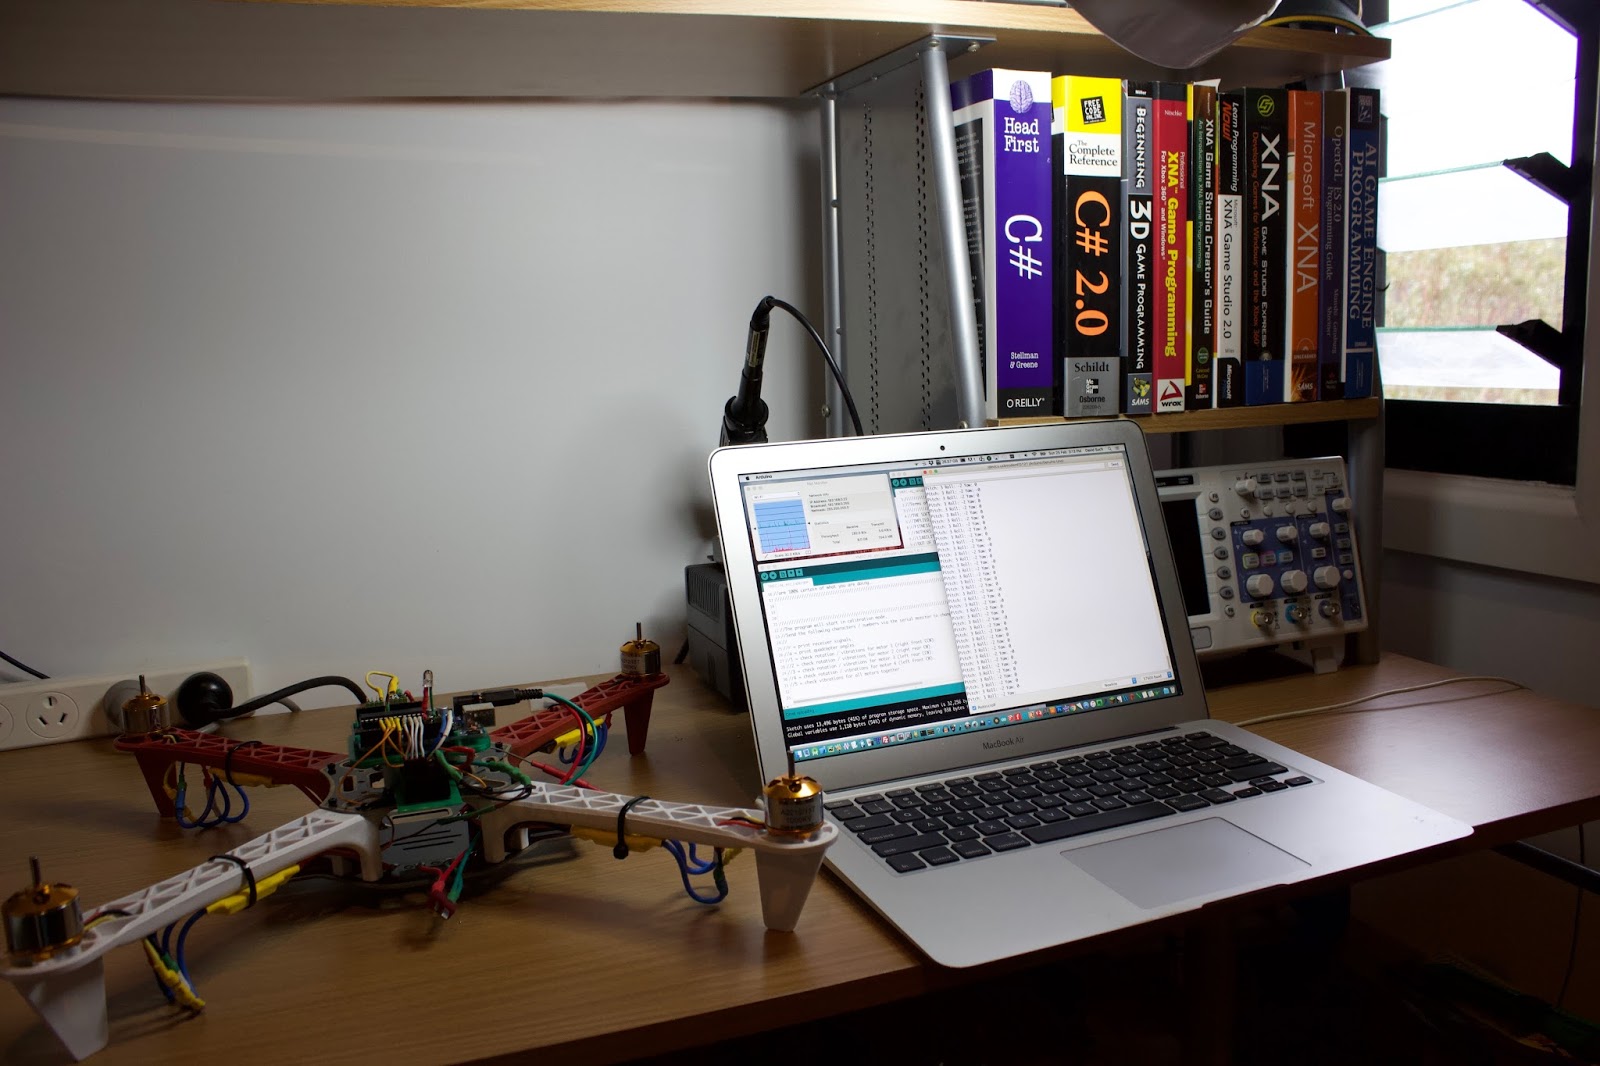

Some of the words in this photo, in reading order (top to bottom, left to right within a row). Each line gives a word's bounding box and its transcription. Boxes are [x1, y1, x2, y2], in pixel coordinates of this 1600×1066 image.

[1083, 99, 1101, 108] FREE
[1084, 106, 1102, 115] CODE
[1222, 101, 1232, 142] Now!
[1004, 117, 1040, 135] Head
[1198, 120, 1204, 129] An
[1004, 135, 1040, 153] First
[1069, 144, 1115, 157] Complete
[1070, 155, 1118, 167] Reference
[1135, 107, 1147, 189] BEGINNING
[1230, 129, 1239, 192] Programming
[1332, 126, 1343, 181] OpenGL
[1365, 143, 1376, 166] AI
[1205, 152, 1214, 189] Game
[1261, 133, 1280, 221] XNA
[1303, 121, 1316, 209] Microsoft
[1204, 191, 1214, 232] Studio
[1333, 187, 1342, 200] ES
[1363, 174, 1376, 239] GAME
[1075, 190, 1111, 257] C#
[1130, 200, 1152, 240] 3D
[1167, 198, 1179, 245] Game
[1224, 199, 1232, 229] XNA
[1325, 187, 1333, 250] Programming
[1333, 205, 1342, 222] 2.0
[1004, 214, 1043, 280] C#
[1159, 224, 1167, 257] Windows
[1223, 233, 1233, 271] Game
[1350, 151, 1364, 319] PROGRAMMING
[1136, 243, 1147, 280] GAME
[1204, 236, 1213, 296] Creator's
[1297, 222, 1319, 293] XNA
[1075, 269, 1110, 336] 2.0
[1164, 249, 1179, 357] Programming
[1223, 275, 1232, 316] Studio
[1362, 249, 1374, 329] ENGINE
[1135, 283, 1147, 370] PROGRAMMING
[1204, 300, 1212, 334] Guide
[1223, 320, 1232, 339] 2.0
[1010, 352, 1039, 360] Stellman
[1010, 361, 1015, 369] &
[1016, 361, 1039, 369] Greene
[1074, 361, 1110, 373] Schildt
[1079, 395, 1105, 403] Osborne
[1131, 398, 1149, 406] SAMS
[1297, 383, 1313, 391] SAMS
[786, 724, 803, 732] Sketch
[816, 719, 832, 727] 13,496
[832, 718, 847, 726] bytes
[869, 711, 887, 719] program
[888, 708, 905, 717] storage
[906, 706, 921, 715] space.
[922, 703, 940, 711] Maximum
[787, 730, 804, 738] Global
[805, 727, 828, 736] variables
[853, 720, 867, 729] bytes
[888, 713, 906, 722] dynamic
[908, 710, 925, 719] memory,
[925, 707, 943, 716] leaving
[953, 703, 966, 712] bytes
[982, 738, 1014, 750] MacBook
[1015, 735, 1025, 745] Air
